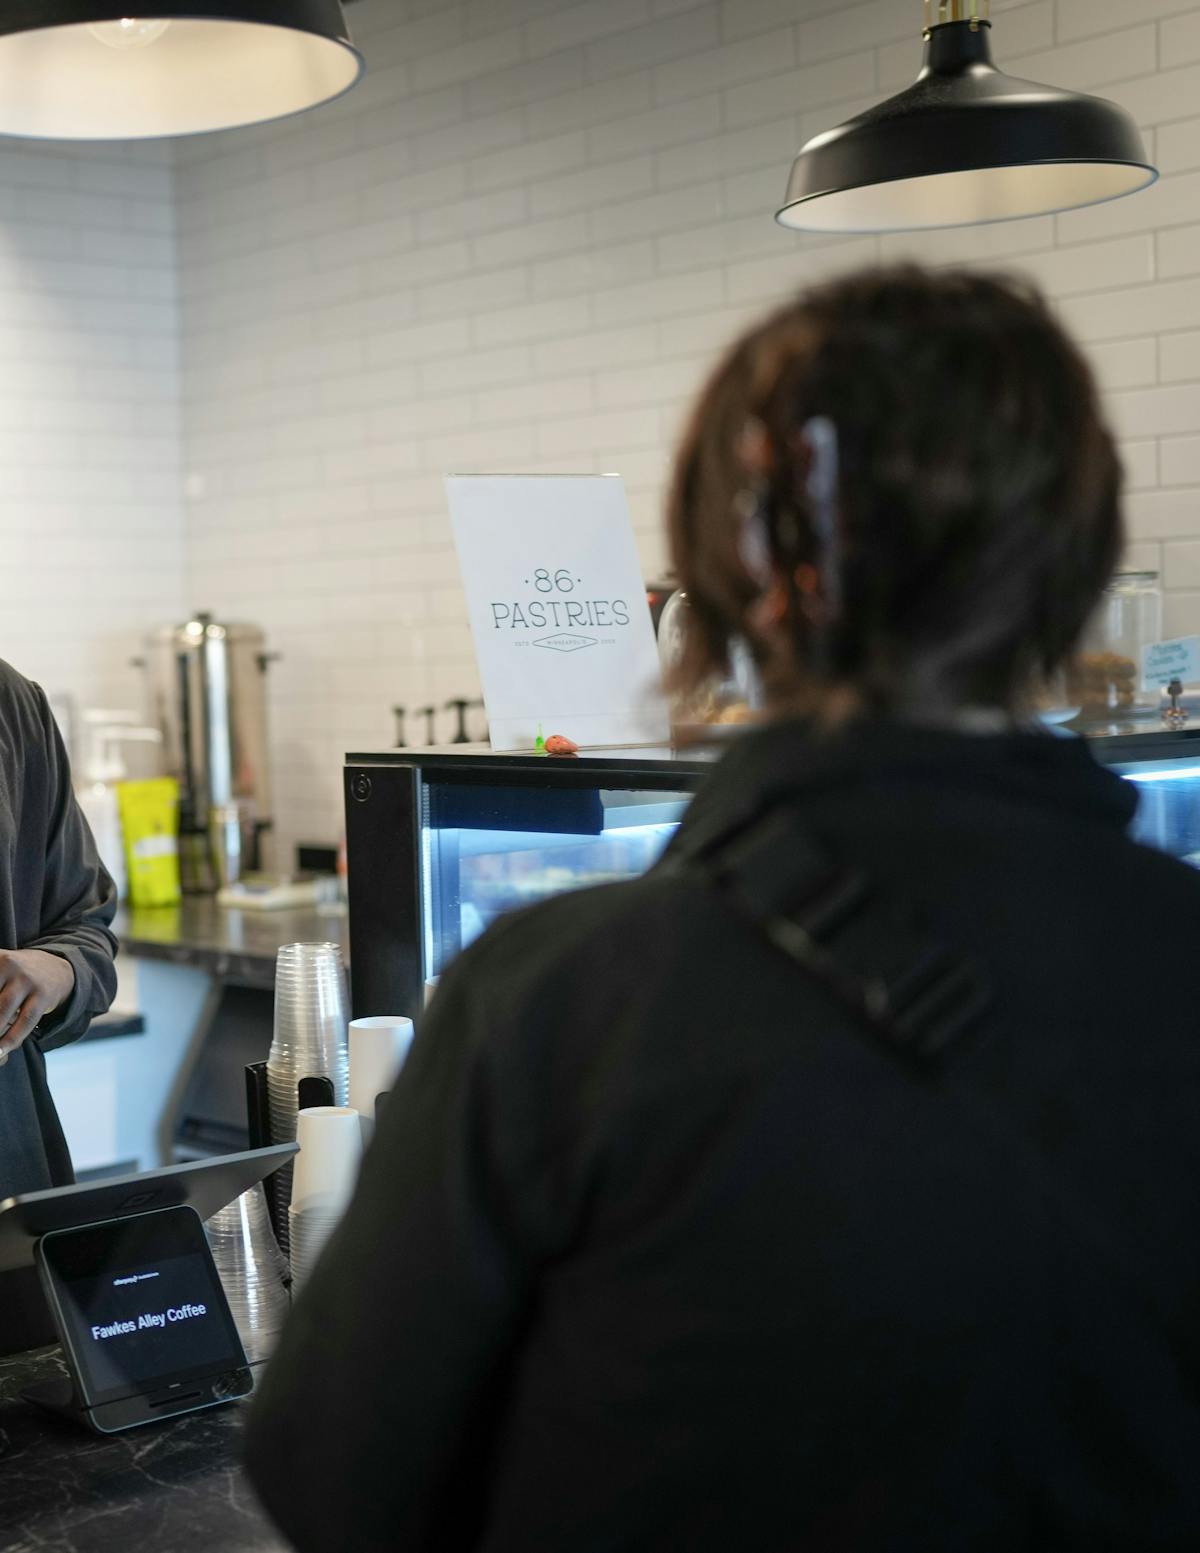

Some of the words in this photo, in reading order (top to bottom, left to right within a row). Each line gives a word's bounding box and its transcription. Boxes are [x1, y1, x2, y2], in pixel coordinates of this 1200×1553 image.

[490, 599, 630, 629] PASTRIES
[91, 1320, 137, 1340] Fawkes
[138, 1313, 166, 1329] Alley
[166, 1303, 207, 1322] Coffee
